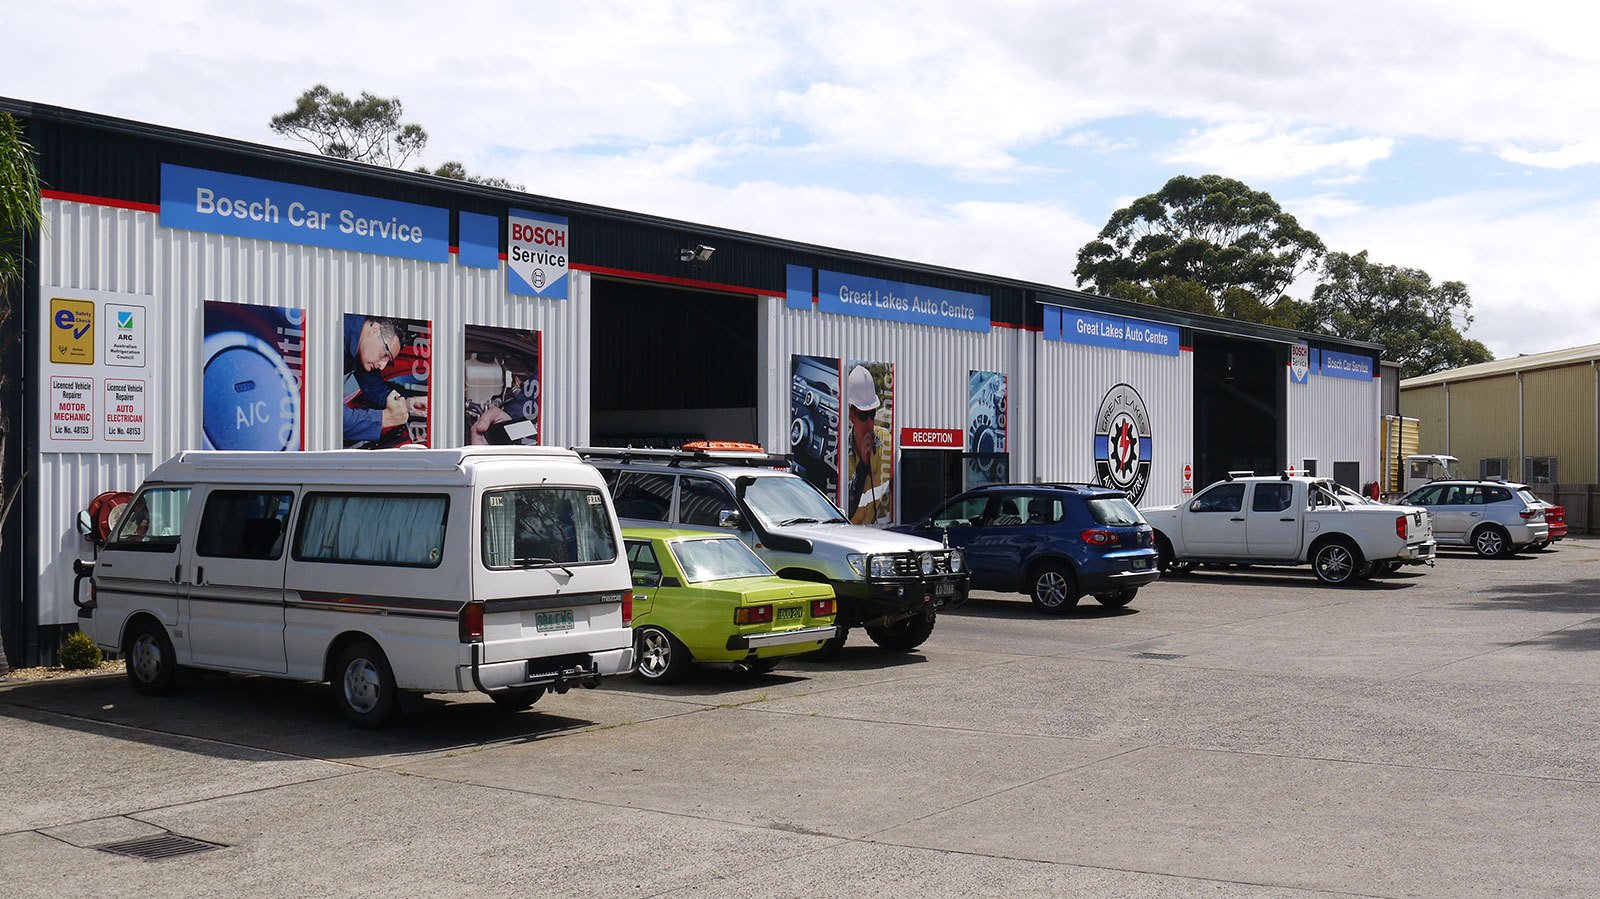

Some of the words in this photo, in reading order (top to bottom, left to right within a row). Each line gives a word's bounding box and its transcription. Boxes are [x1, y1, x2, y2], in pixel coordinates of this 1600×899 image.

[195, 187, 280, 225] Bosch
[287, 201, 331, 231] Car
[338, 209, 423, 245] Service
[512, 223, 565, 248] BOSCH
[512, 245, 566, 268] Service
[839, 285, 872, 307] Great
[875, 290, 909, 311] Lakes
[911, 296, 938, 315] Auto
[940, 300, 975, 320] Centre
[1076, 318, 1099, 335] Great
[1100, 322, 1124, 339] Lakes
[1125, 326, 1144, 342] Auto
[1144, 330, 1168, 345] Centre
[1292, 345, 1307, 357] BOSCH
[1327, 357, 1342, 369] Bosch
[1343, 360, 1351, 371] Car
[1352, 361, 1369, 373] Service
[53, 381, 74, 390] Licenced
[75, 381, 91, 391] Vehicle
[107, 383, 126, 392] Licenced
[127, 384, 143, 393] Vehicle
[62, 390, 82, 400] Repairer
[115, 393, 134, 402] Repairer
[59, 402, 86, 411] MOTOR
[116, 405, 134, 413] AUTO
[53, 412, 91, 421] MECHANIC
[107, 414, 143, 423] ELECTRICIAN
[236, 401, 270, 430] A/C
[1102, 394, 1122, 433] GREAT
[1124, 396, 1146, 434] LAKES
[55, 425, 63, 434] Lic
[63, 426, 73, 434] No.
[73, 426, 89, 434] 48153
[108, 427, 116, 435] Lic
[116, 427, 125, 435] No.
[126, 427, 141, 435] 48153
[912, 431, 953, 443] RECEPTION
